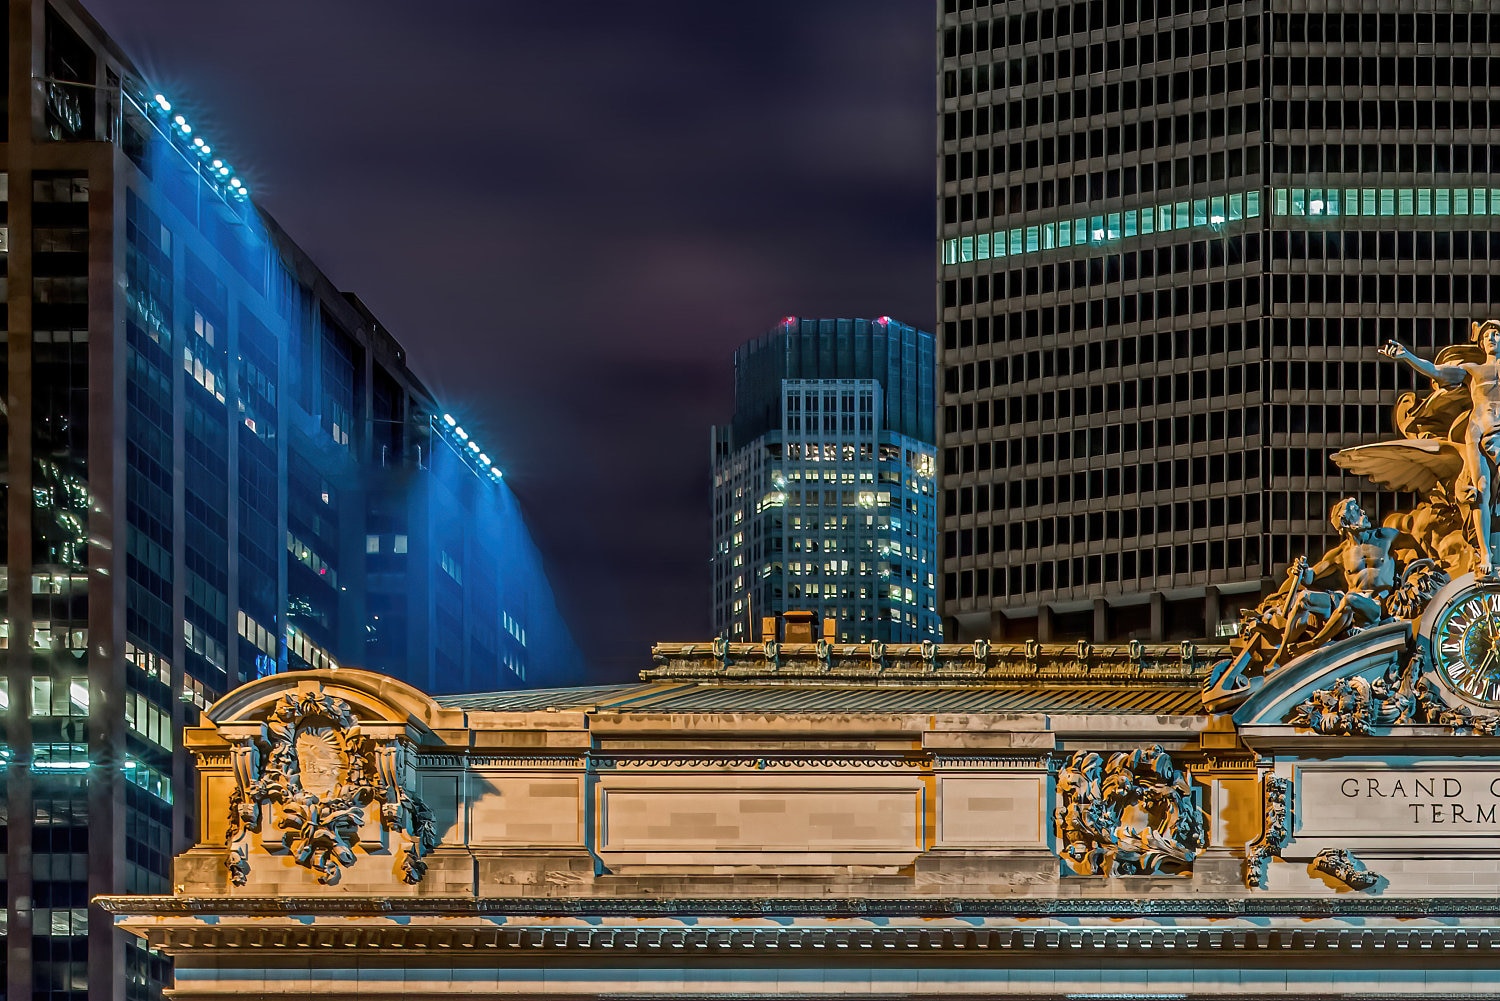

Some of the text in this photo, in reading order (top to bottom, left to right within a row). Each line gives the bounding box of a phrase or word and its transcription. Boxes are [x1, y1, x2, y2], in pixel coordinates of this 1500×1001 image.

[1466, 600, 1482, 618] XI
[1448, 619, 1466, 632] X
[1442, 643, 1459, 652] IX
[1341, 778, 1461, 797] GRAND
